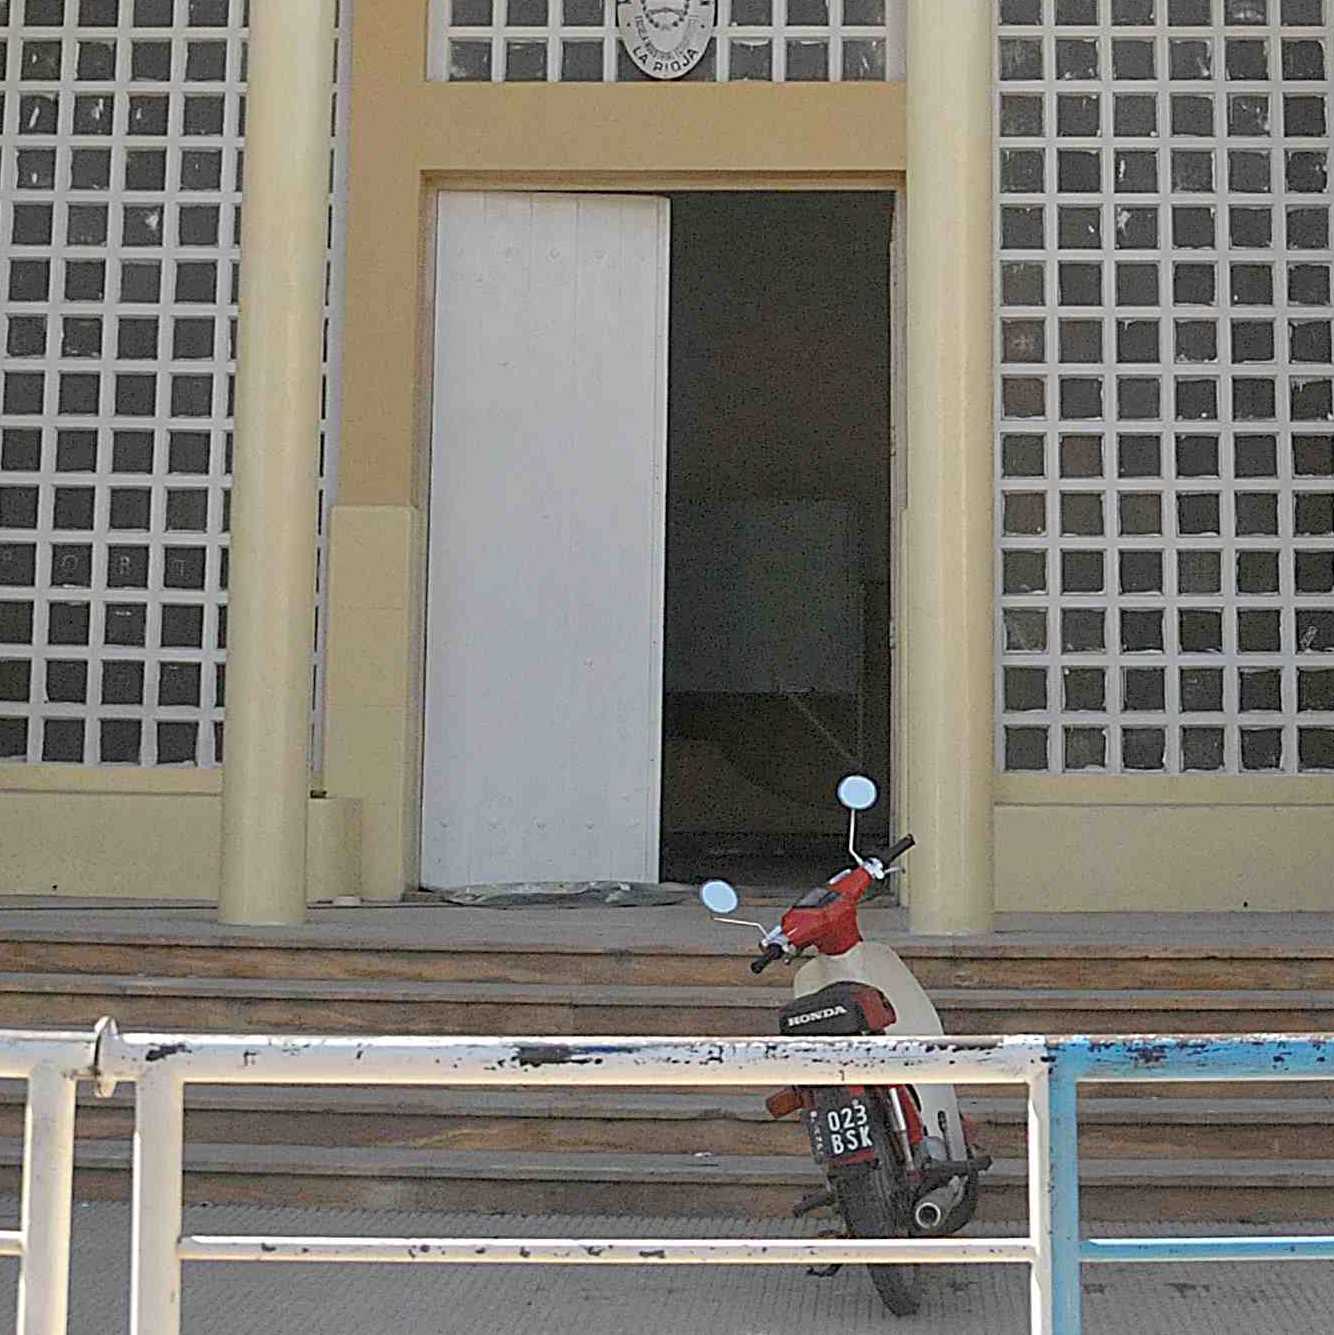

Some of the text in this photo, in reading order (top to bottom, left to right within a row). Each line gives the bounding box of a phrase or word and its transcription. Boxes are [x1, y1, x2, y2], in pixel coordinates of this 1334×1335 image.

[633, 46, 699, 72] LA RIOJA
[787, 1004, 848, 1027] HONDA
[827, 1104, 868, 1132] 023
[831, 1125, 874, 1155] BSK
